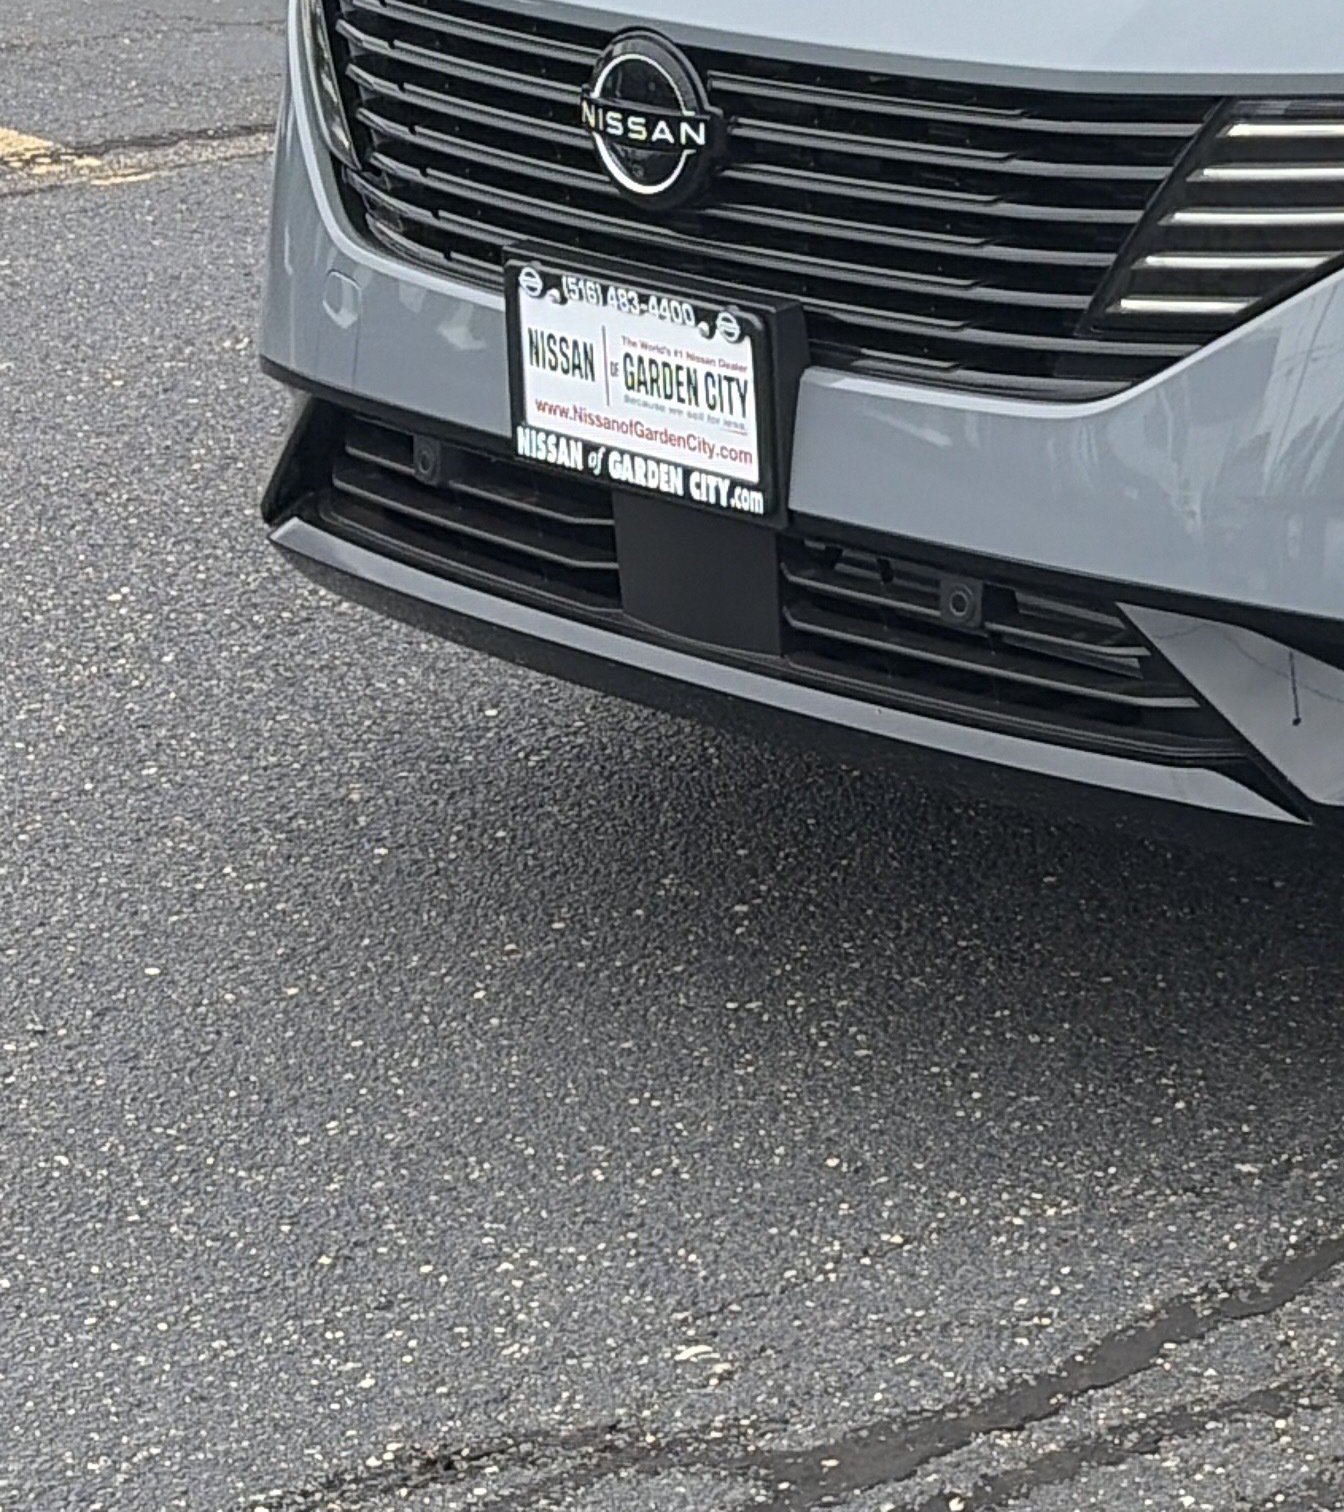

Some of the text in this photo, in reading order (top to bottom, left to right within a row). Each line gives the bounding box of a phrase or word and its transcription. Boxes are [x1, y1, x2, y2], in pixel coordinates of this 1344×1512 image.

[580, 99, 707, 146] NISSAN
[561, 274, 696, 327] (516) 483-4400
[527, 326, 596, 382] NISSAN
[621, 335, 638, 348] The
[622, 351, 748, 419] GARDEN CITY
[535, 397, 754, 465] www.NissanofGardenCity.com
[516, 425, 764, 516] NISSAN of GARDEN CITY.com
